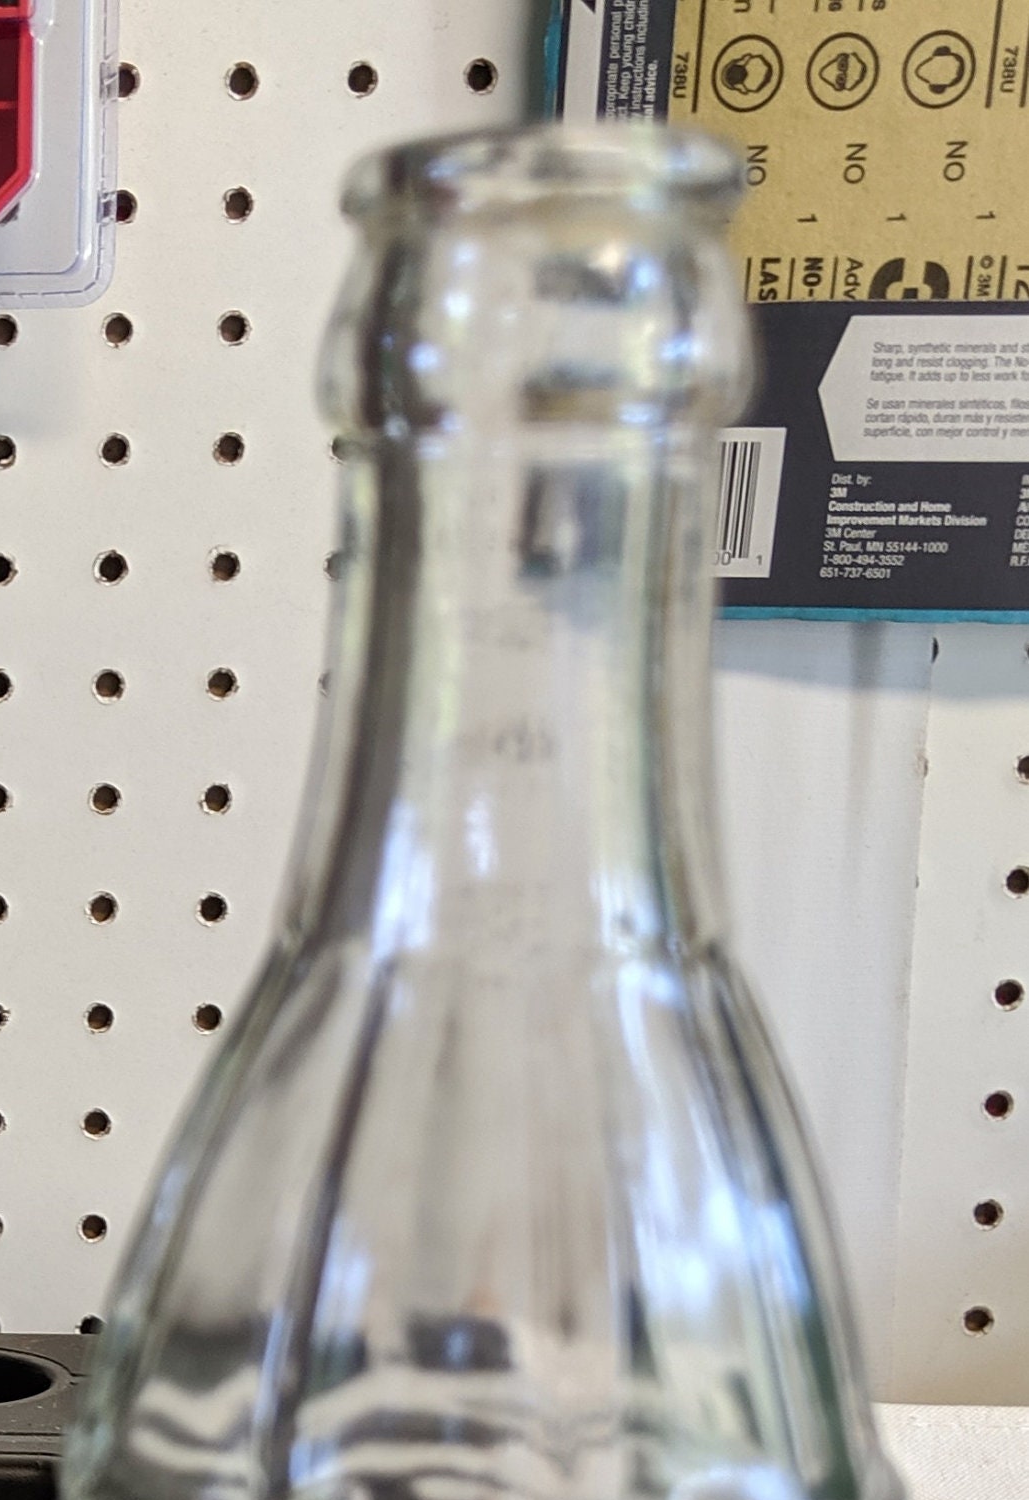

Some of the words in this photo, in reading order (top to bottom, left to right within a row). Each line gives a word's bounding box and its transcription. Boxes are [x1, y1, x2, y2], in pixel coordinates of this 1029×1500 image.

[609, 11, 622, 59] personal
[622, 34, 635, 68] young
[672, 51, 691, 98] 738U
[1000, 46, 1020, 94] 738U
[631, 46, 646, 110] instructions
[645, 60, 659, 102] advice.
[605, 63, 620, 119] ppropriate
[619, 71, 632, 100] Keep
[744, 145, 769, 187] NO
[842, 142, 868, 185] NO
[943, 140, 969, 183] NO
[908, 342, 951, 355] synthetic
[954, 342, 996, 353] minerals
[999, 343, 1018, 353] and
[872, 356, 893, 369] long
[895, 356, 914, 367] and
[916, 356, 943, 367] resist
[995, 356, 1012, 367] The
[909, 371, 917, 381] It
[918, 371, 941, 381] adds
[944, 372, 956, 382] up
[959, 371, 970, 381] to
[972, 371, 991, 381] less
[994, 371, 1017, 381] work
[866, 398, 879, 410] Se
[882, 400, 905, 409] usan
[908, 399, 955, 409] minerales
[865, 413, 895, 423] cortan
[933, 412, 961, 423] duran
[963, 412, 984, 423] más
[986, 414, 992, 425] y
[915, 427, 933, 437] con
[936, 427, 963, 439] mejor
[966, 427, 999, 437] control
[1001, 428, 1008, 439] y
[831, 474, 853, 485] Dist.
[856, 474, 872, 487] by:
[829, 487, 847, 498] 3M
[828, 501, 896, 513] Construction
[898, 501, 918, 513] and
[920, 501, 952, 513] Home
[826, 514, 896, 527] Improvement
[898, 515, 942, 526] Markets
[944, 515, 987, 527] Division
[825, 528, 841, 538] 3M
[843, 528, 877, 539] Center
[823, 541, 836, 552] St.
[839, 541, 863, 553] Paul,
[866, 542, 884, 552] MN
[886, 542, 948, 553] 55144-1000
[755, 554, 763, 566] 1
